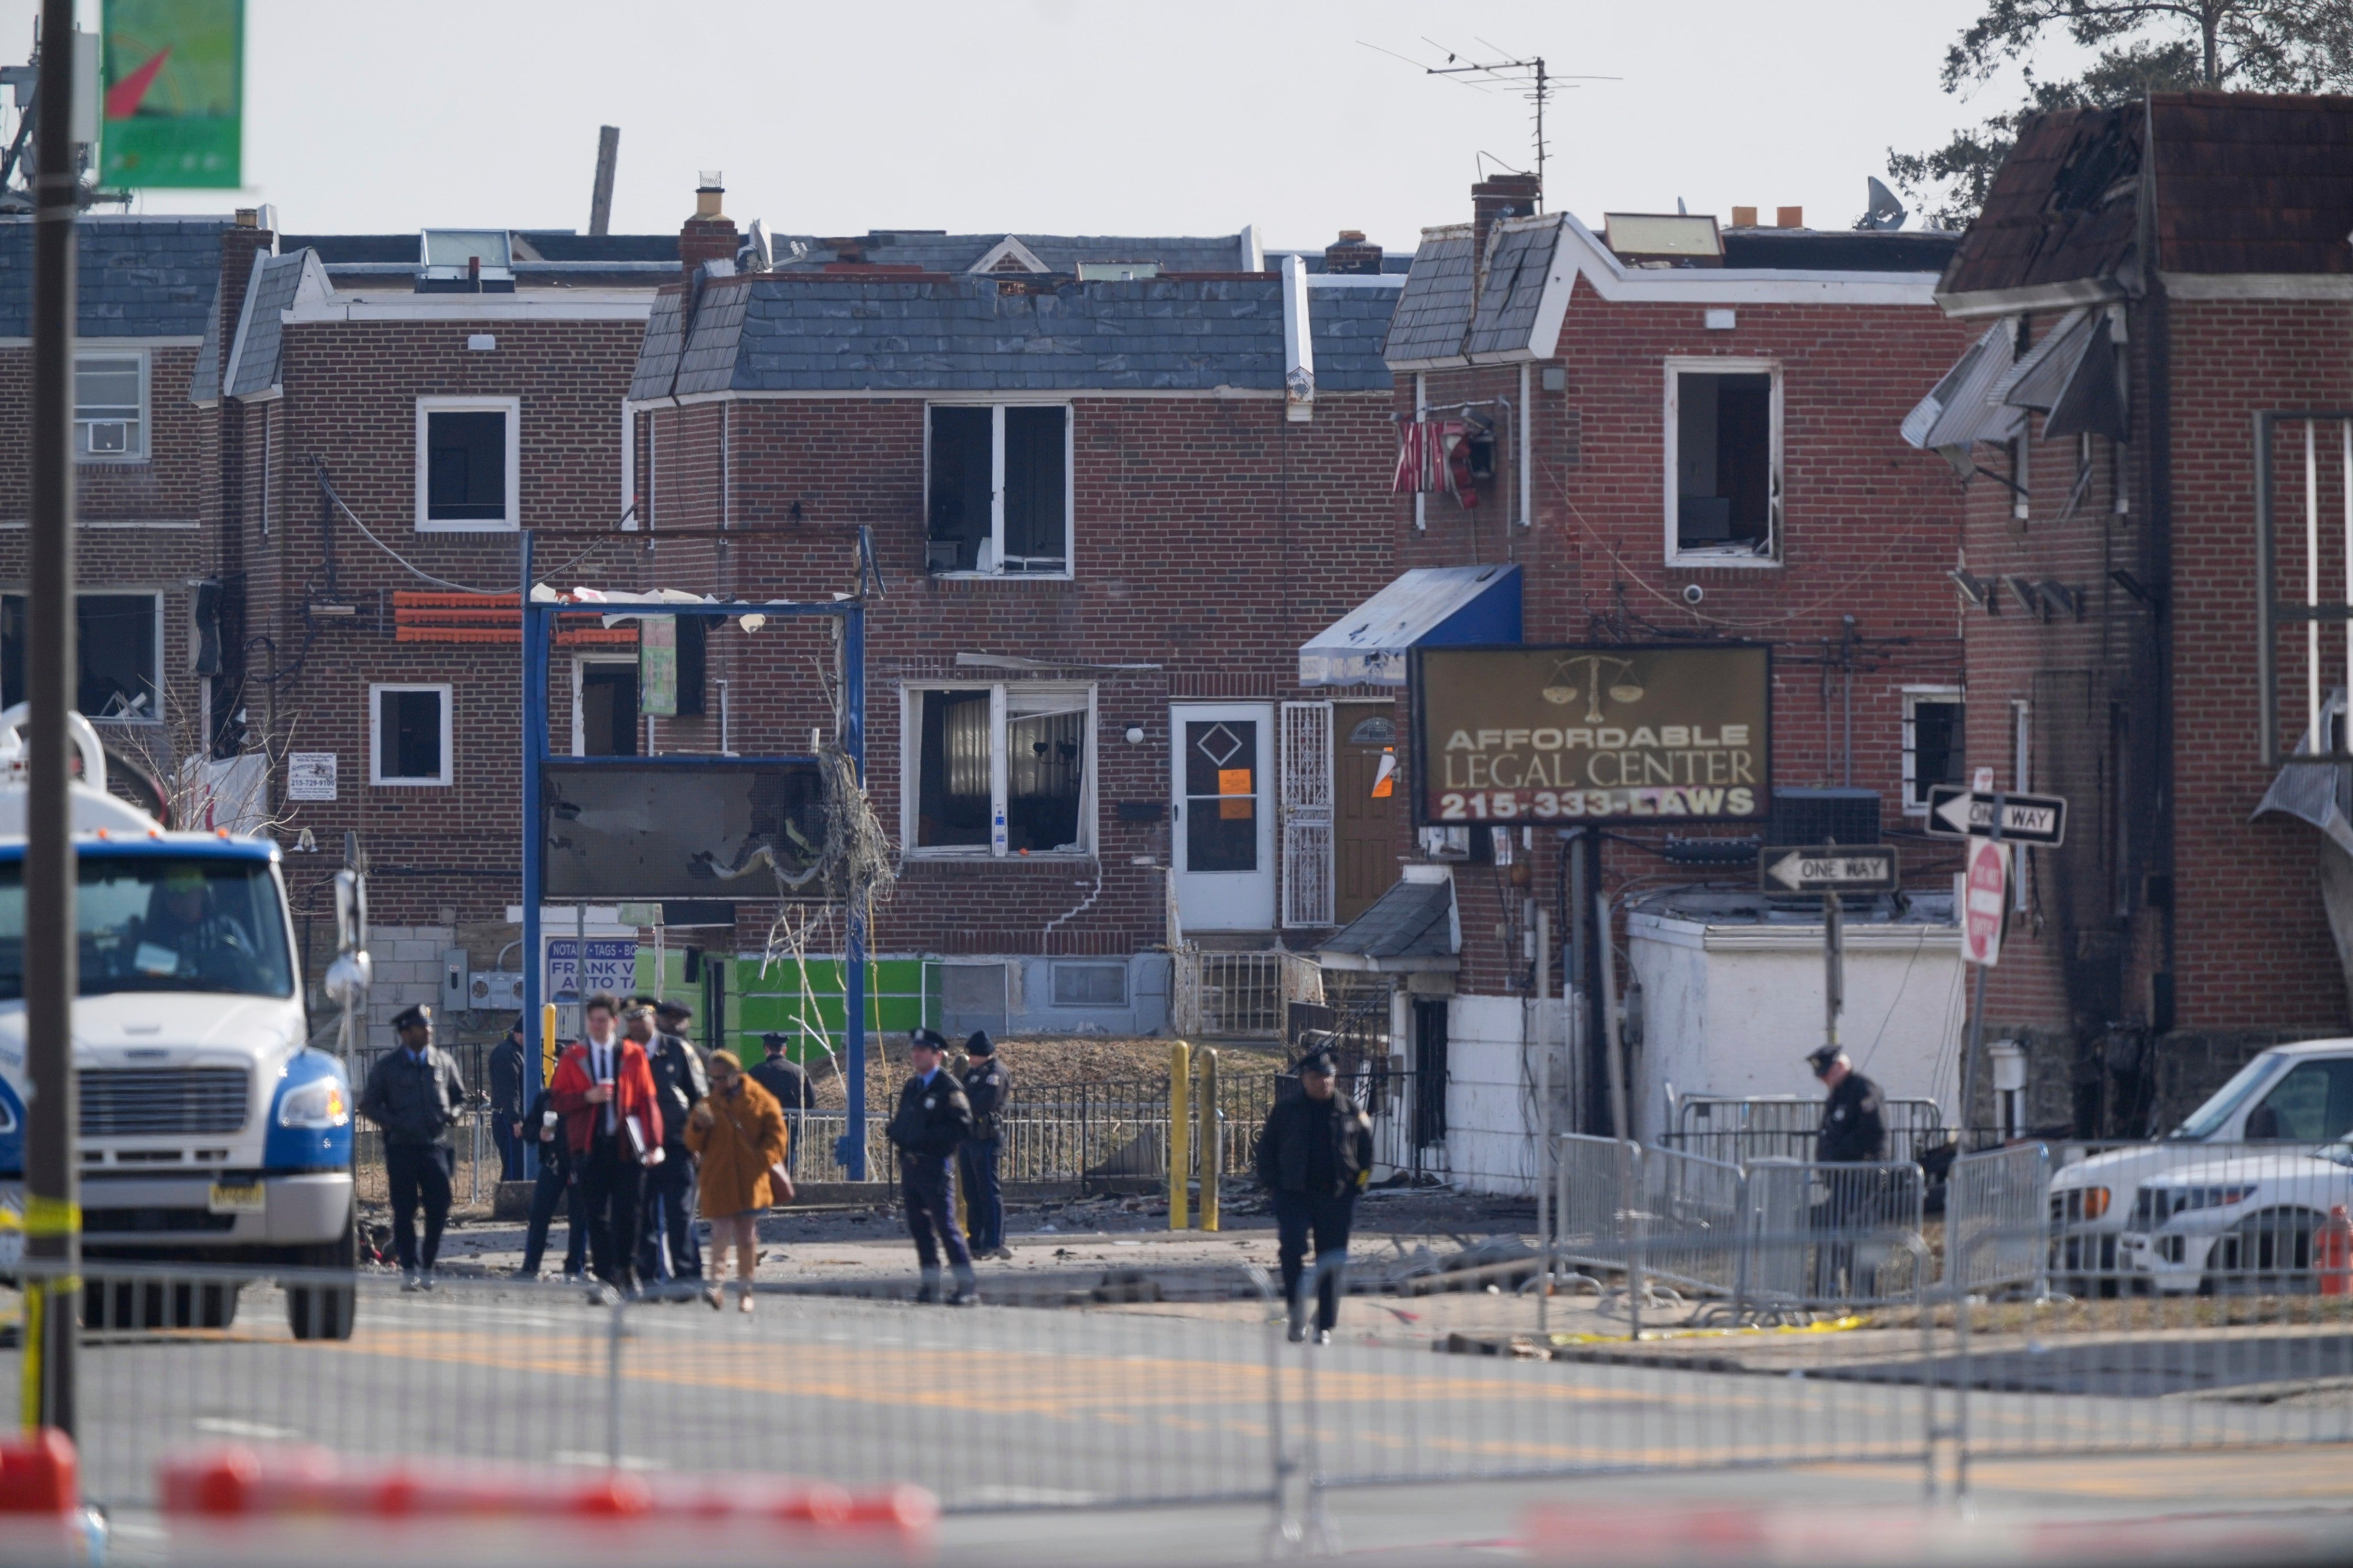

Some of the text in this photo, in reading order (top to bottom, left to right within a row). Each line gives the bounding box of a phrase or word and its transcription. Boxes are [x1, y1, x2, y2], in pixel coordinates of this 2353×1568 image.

[1445, 724, 1750, 750] AFFORDABLE
[1443, 749, 1756, 789] LEGAL CENTER
[1441, 787, 1755, 819] 215-333-LAWS
[1969, 803, 2050, 827] ON WAY
[1802, 859, 1882, 878] ONE WAY
[553, 944, 588, 956] NOTAY
[594, 944, 616, 956] TAGS
